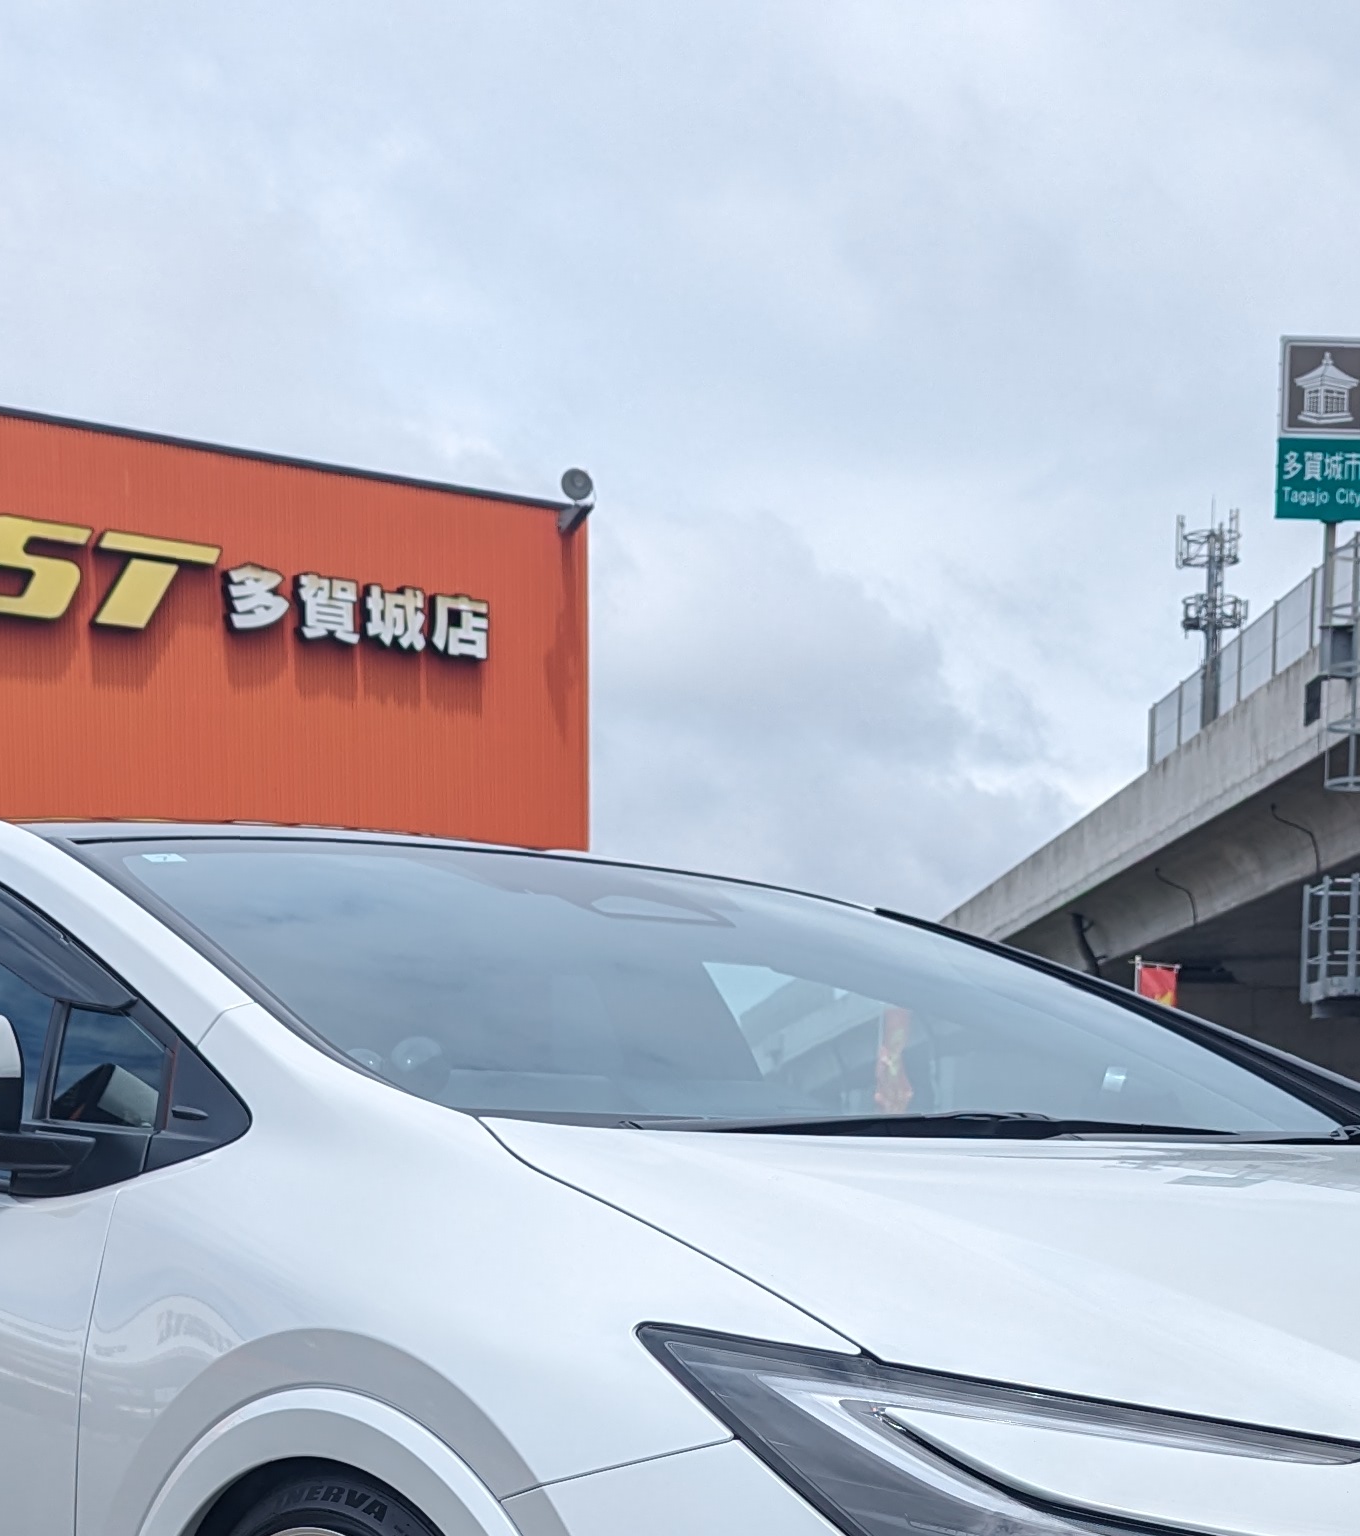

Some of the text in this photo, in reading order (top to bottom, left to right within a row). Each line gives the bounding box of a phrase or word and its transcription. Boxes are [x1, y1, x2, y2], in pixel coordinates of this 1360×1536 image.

[1282, 486, 1330, 507] Tagajo
[227, 562, 490, 661] 多賀城店
[279, 1485, 389, 1523] NERVA
